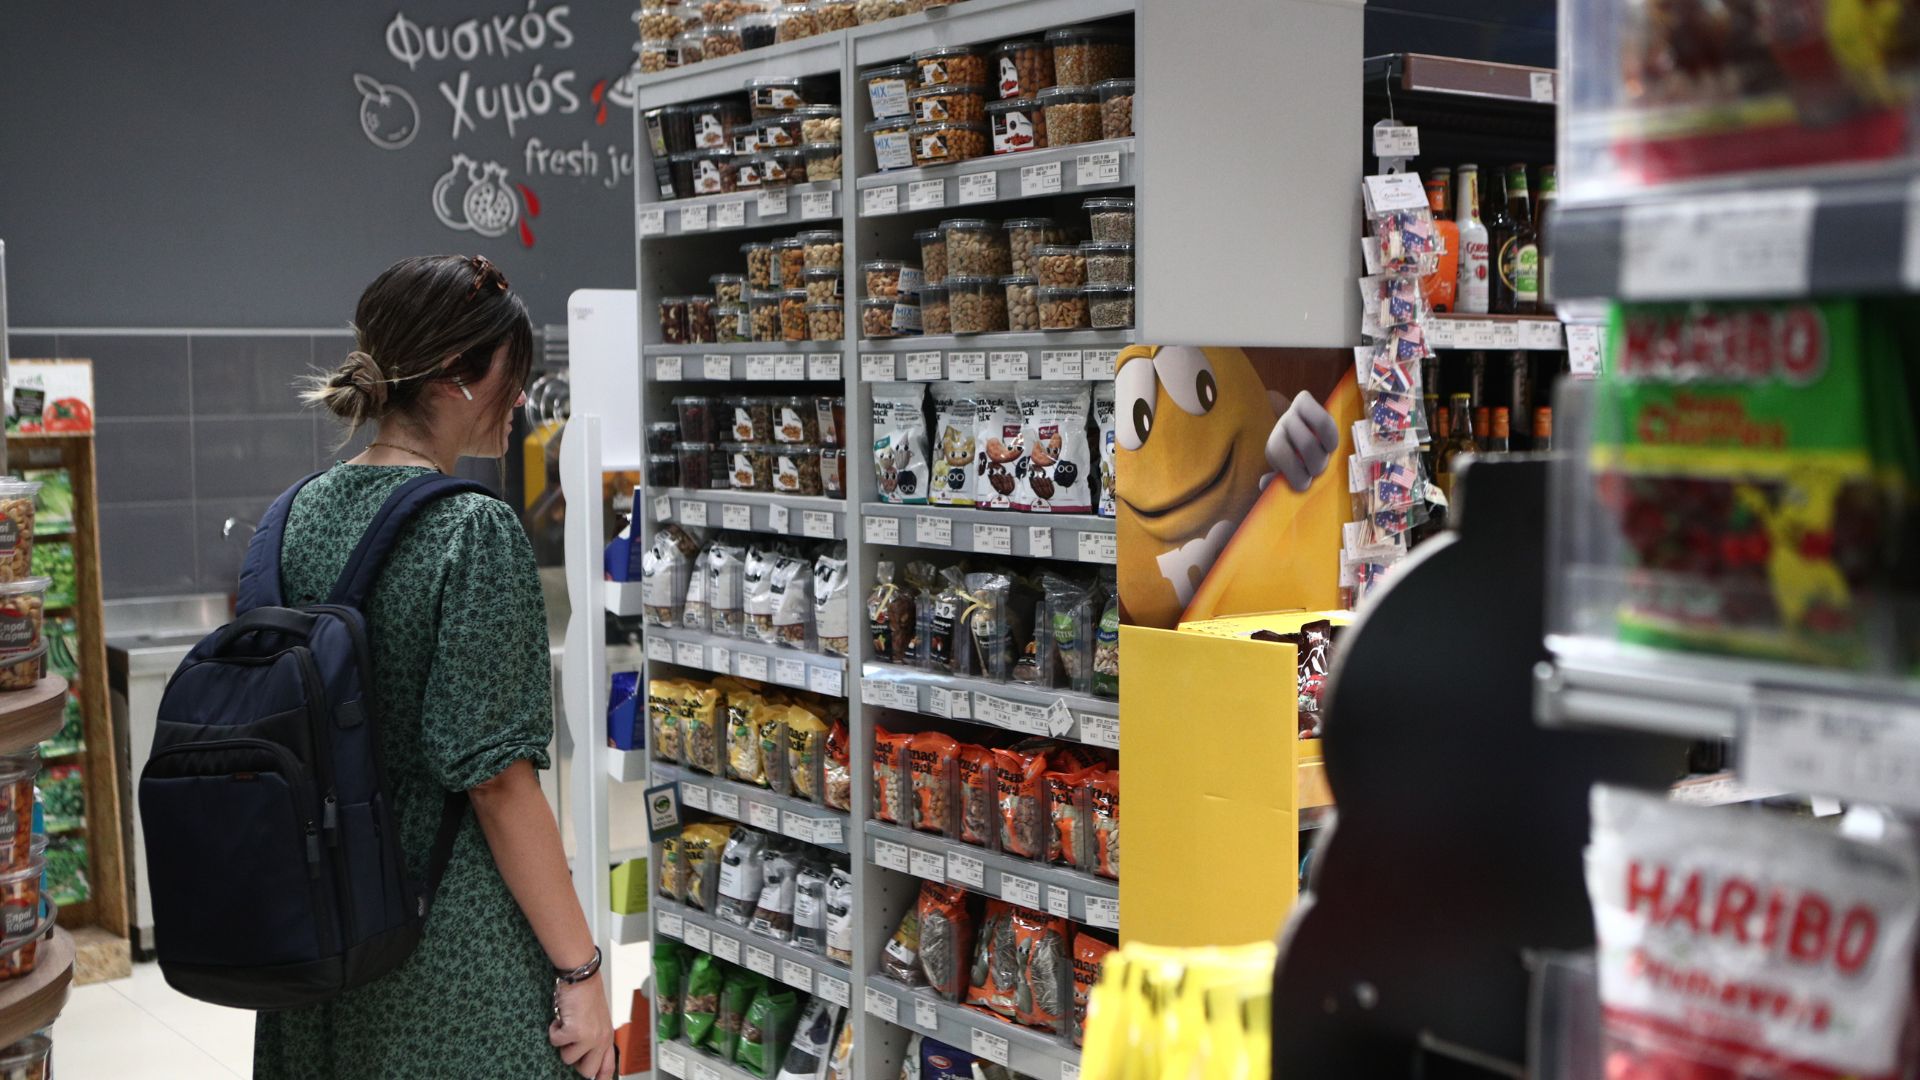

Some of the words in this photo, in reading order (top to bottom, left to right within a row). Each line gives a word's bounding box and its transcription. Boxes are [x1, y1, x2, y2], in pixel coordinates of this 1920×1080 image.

[386, 0, 574, 71] Φυσικός
[439, 64, 580, 140] Χυμός
[525, 137, 598, 176] fresh
[1624, 858, 1880, 978] HARIBO
